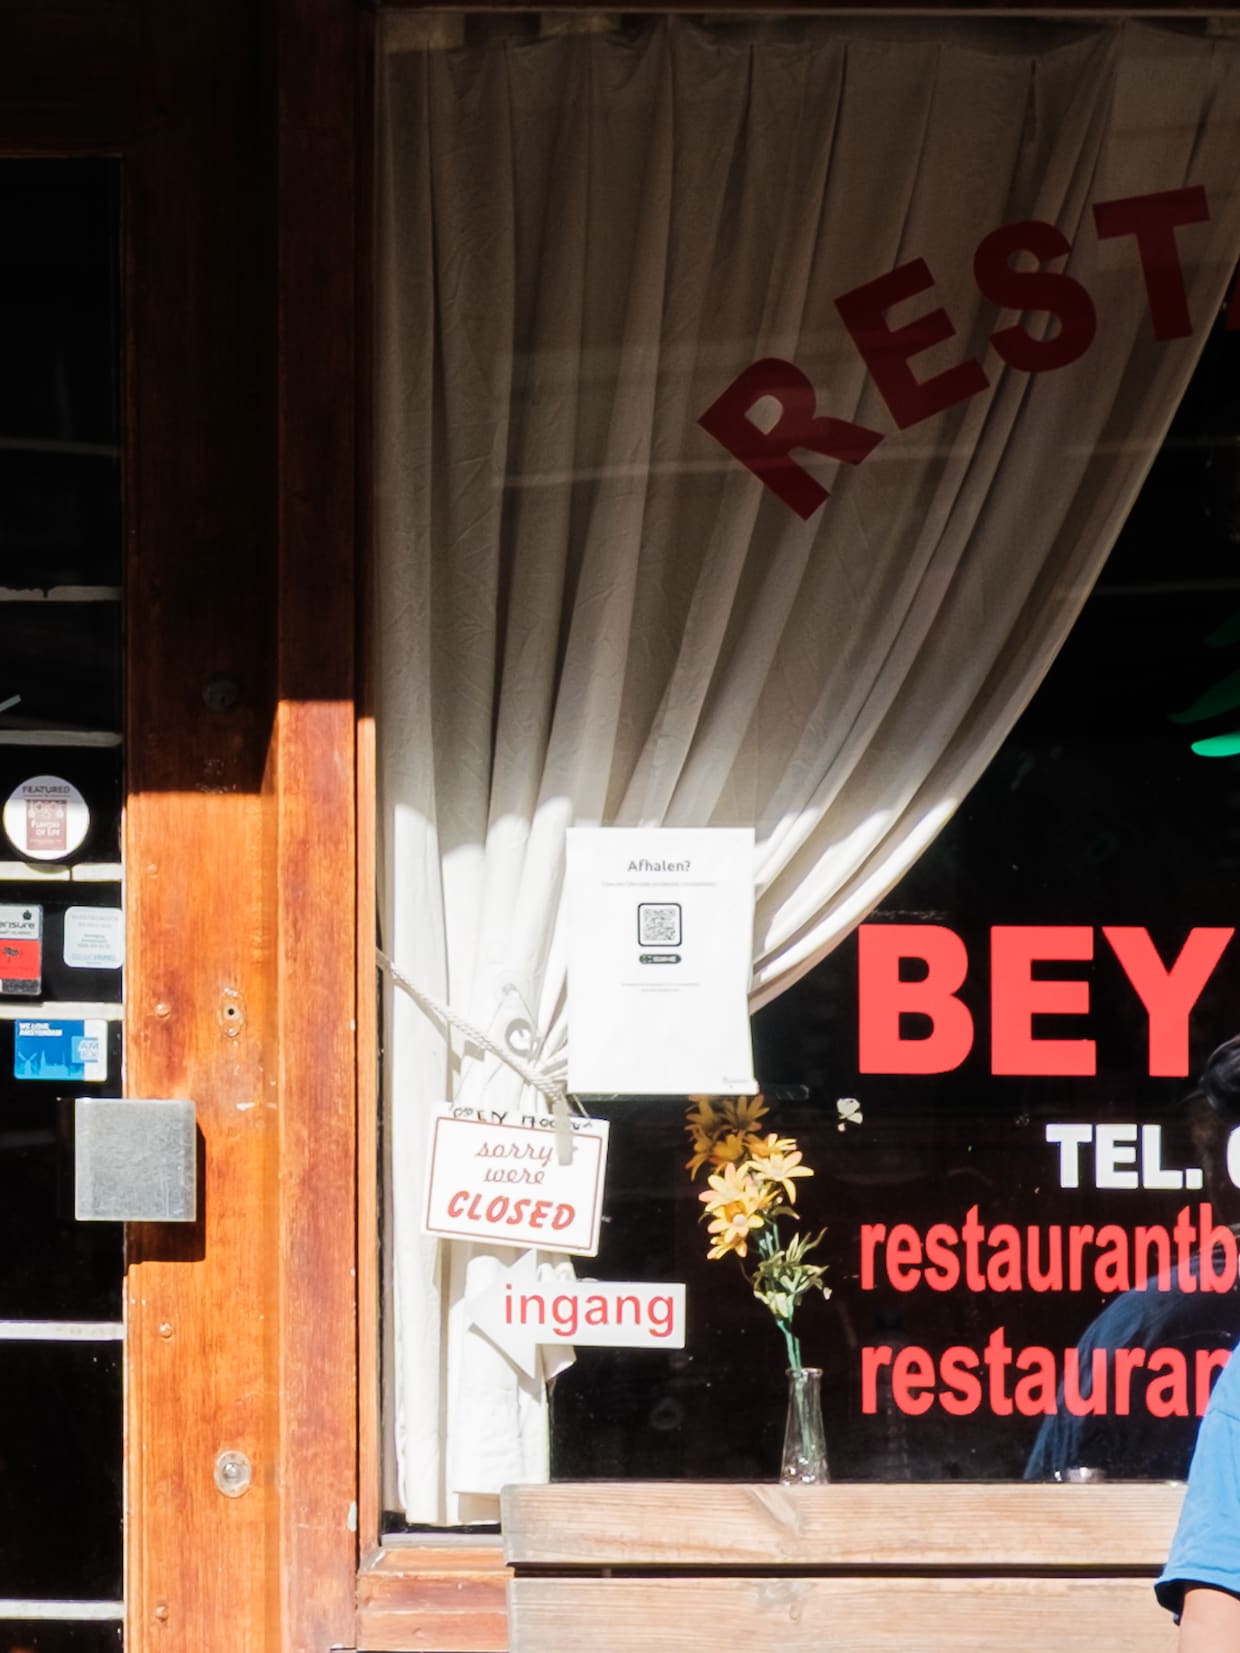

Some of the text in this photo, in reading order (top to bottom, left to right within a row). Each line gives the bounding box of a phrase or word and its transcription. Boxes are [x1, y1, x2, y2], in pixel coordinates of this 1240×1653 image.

[697, 185, 1240, 521] REST
[22, 785, 72, 794] FEATURED
[627, 859, 692, 872] Afhalen?
[858, 923, 1236, 1078] BEY
[475, 1141, 553, 1168] sorry
[483, 1168, 545, 1184] were
[1045, 1123, 1203, 1189] TEL.
[447, 1190, 576, 1230] CLOSED
[860, 1203, 1238, 1293] restaurantb
[503, 1283, 675, 1338] ingang
